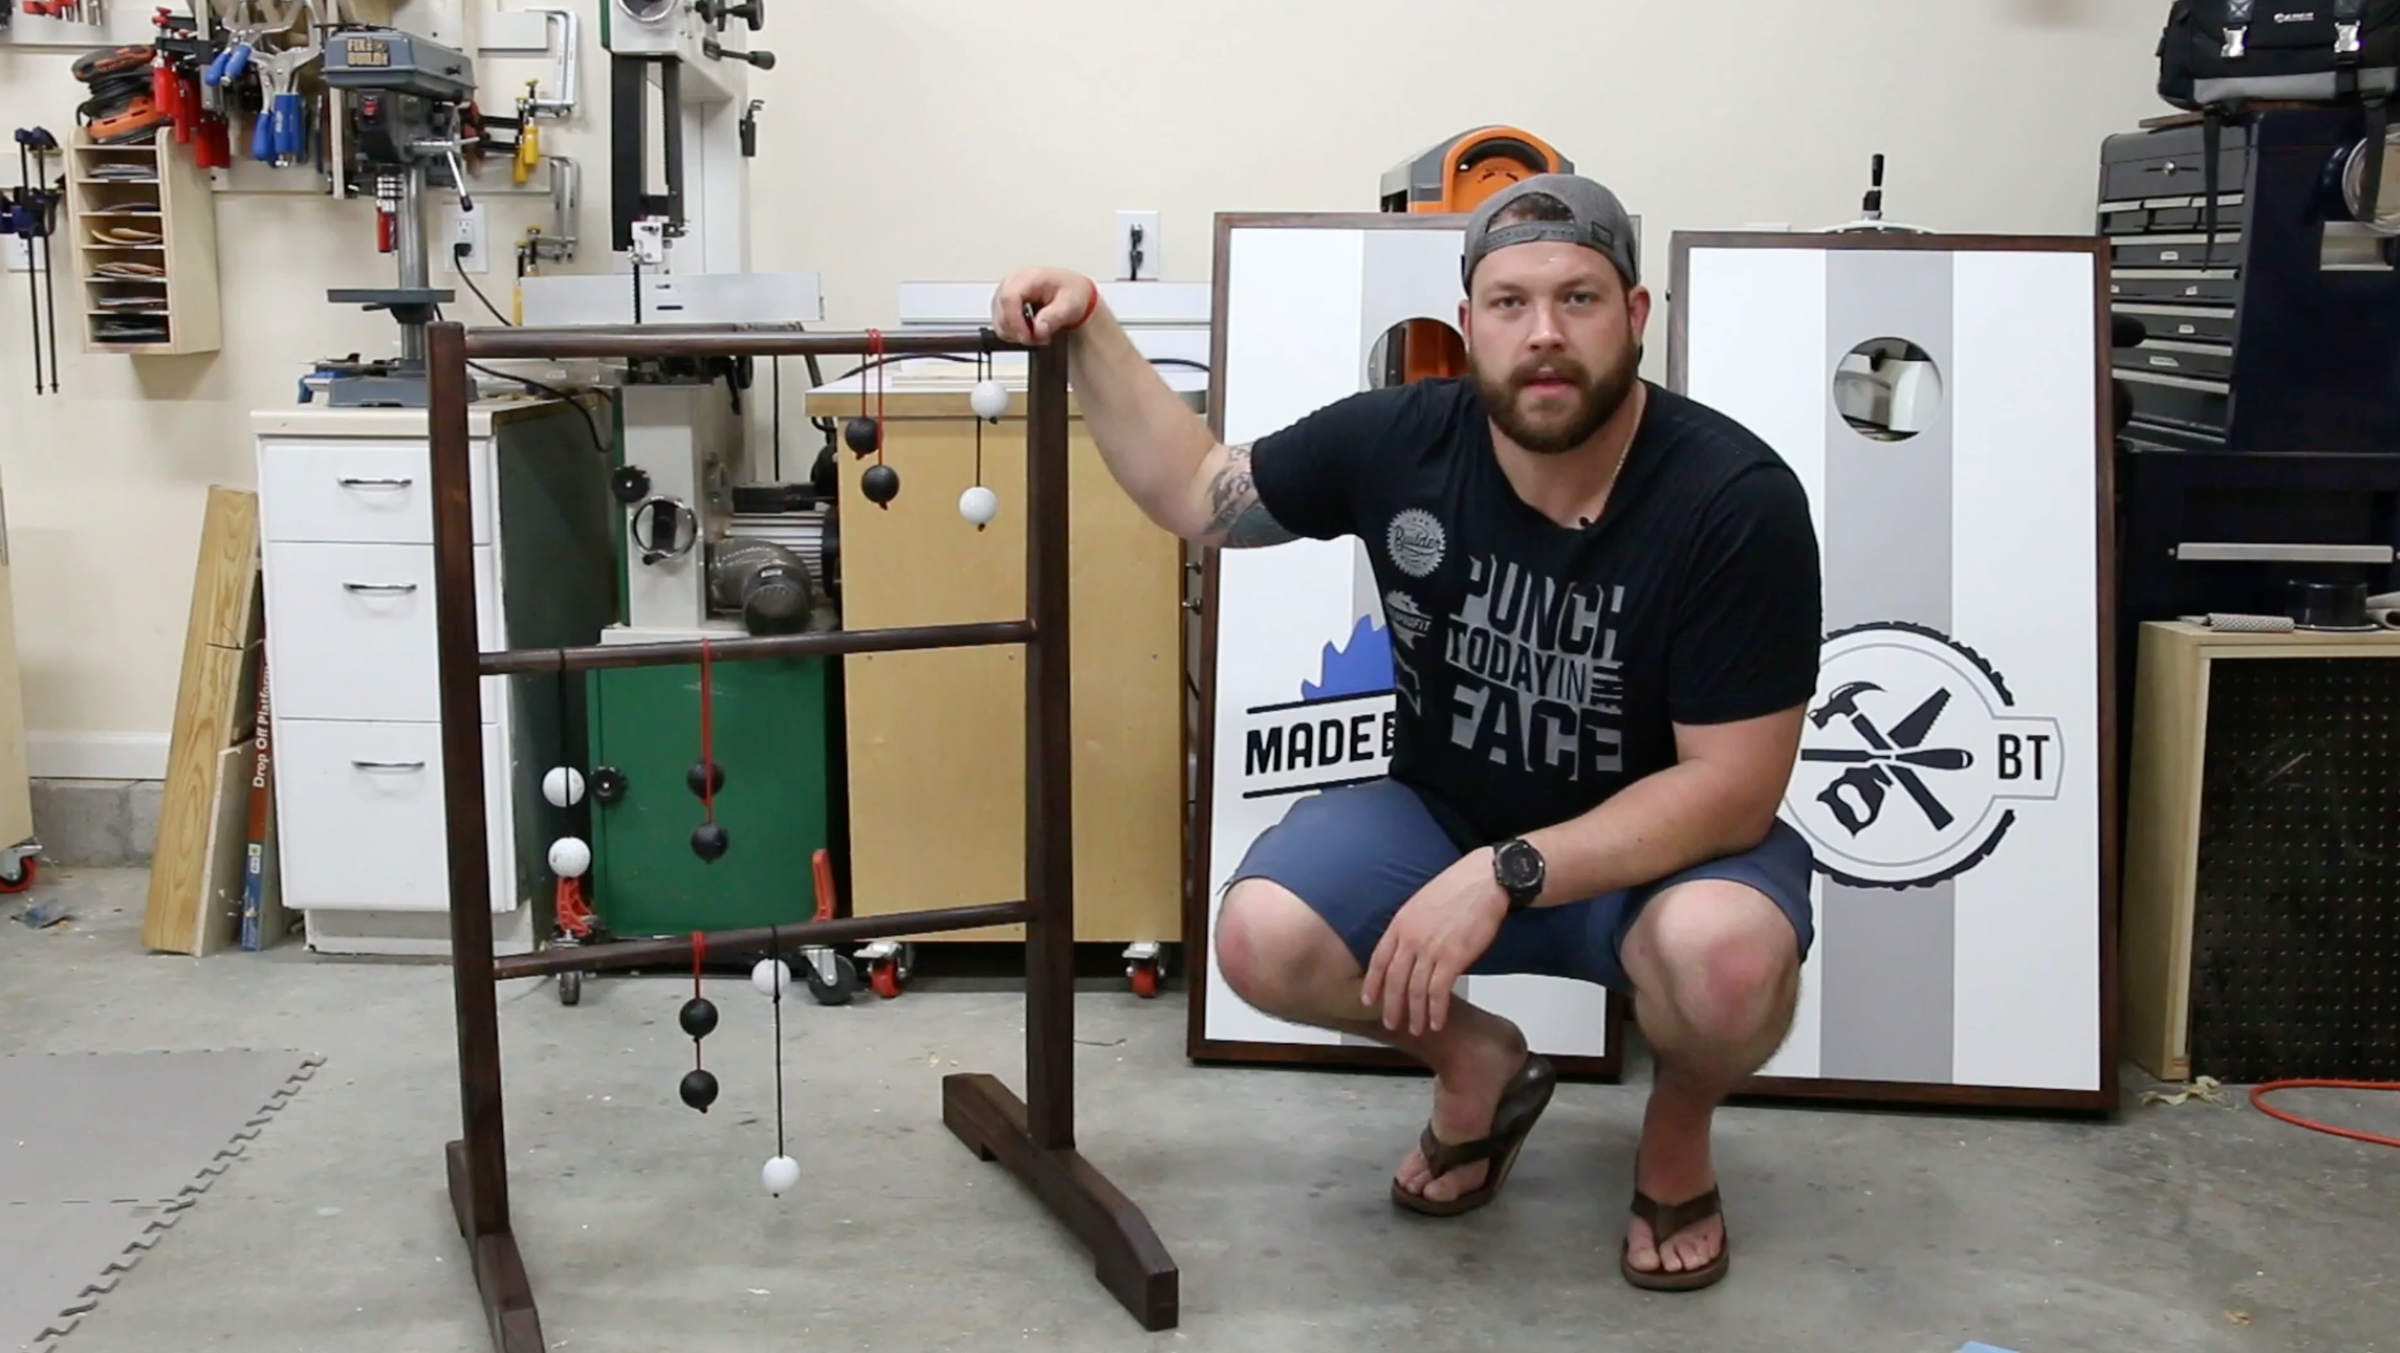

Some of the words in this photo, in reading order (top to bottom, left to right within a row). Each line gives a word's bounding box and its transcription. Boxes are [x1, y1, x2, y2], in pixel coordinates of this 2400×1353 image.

[1462, 553, 1626, 660] PUNCH
[255, 726, 269, 750] Off
[1451, 684, 1624, 781] FACE
[252, 753, 270, 788] Drop
[1998, 733, 2050, 780] BT
